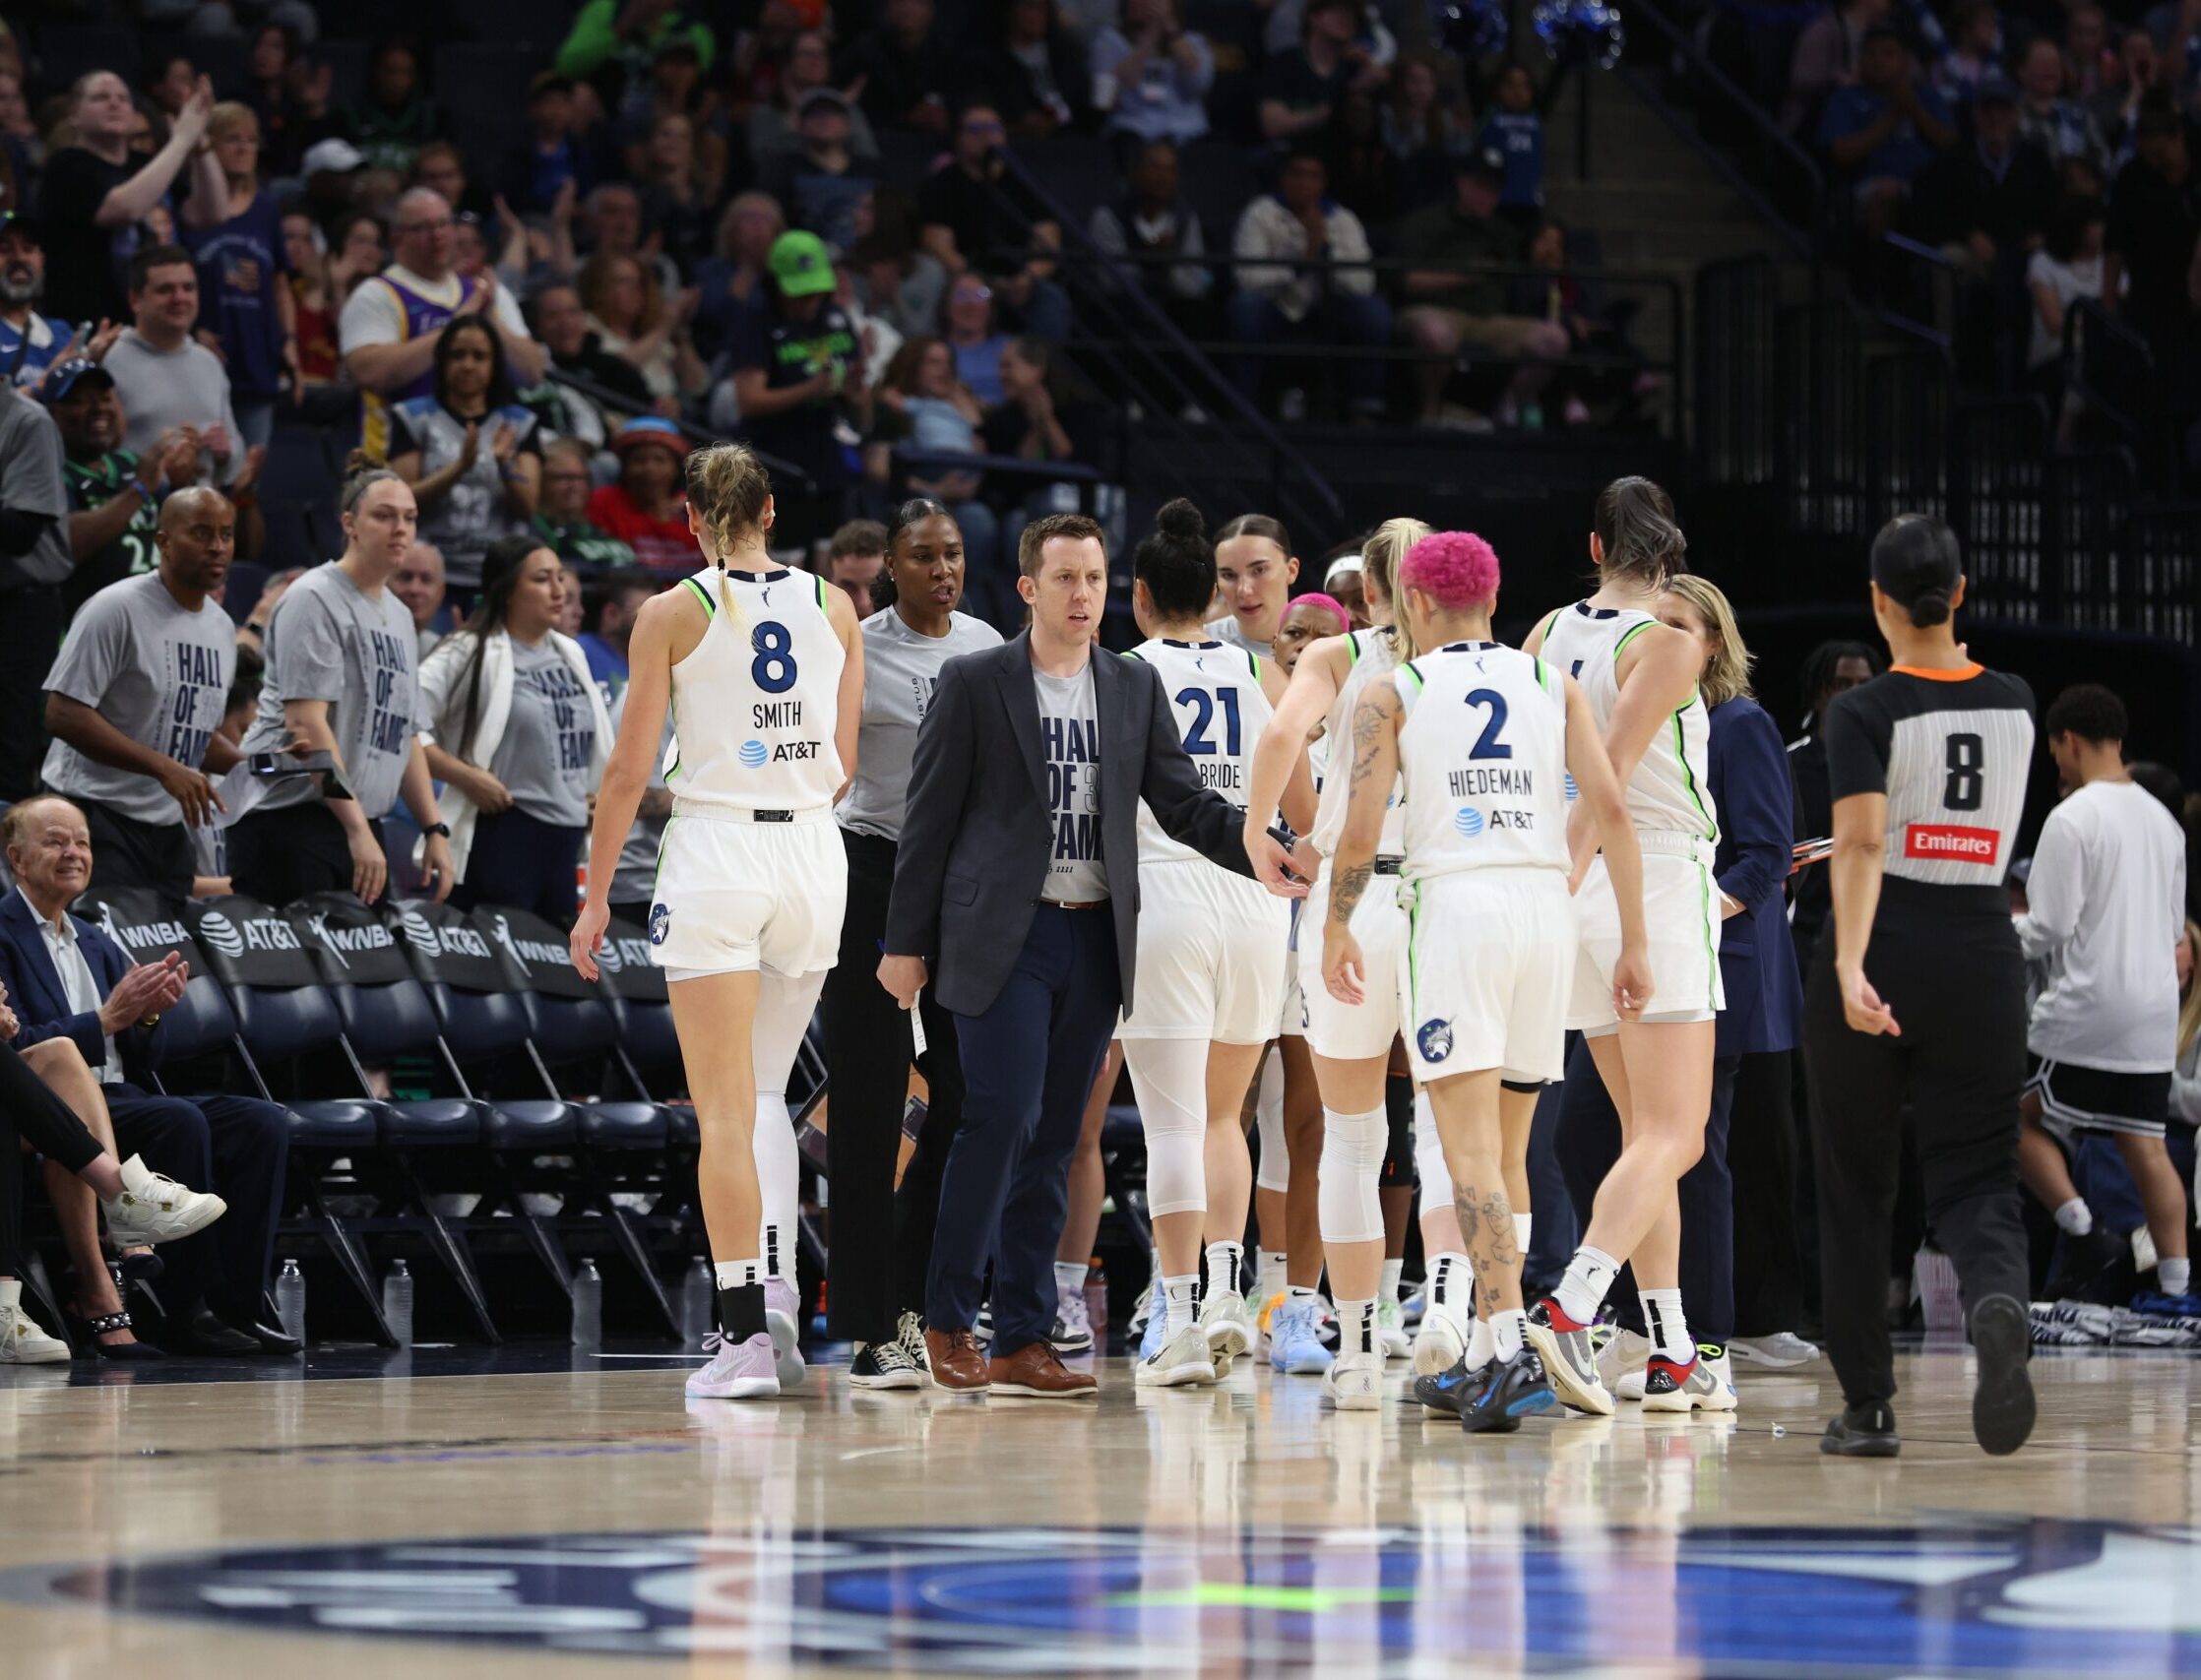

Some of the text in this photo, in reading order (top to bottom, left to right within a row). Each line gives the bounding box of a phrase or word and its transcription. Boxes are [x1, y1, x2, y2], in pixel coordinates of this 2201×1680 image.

[177, 643, 222, 688] HALL
[370, 629, 409, 675] HALL
[751, 621, 797, 694] 8
[173, 684, 200, 725] OF
[376, 668, 395, 709] OF
[753, 701, 801, 728] SMITH
[1174, 687, 1241, 756] 21
[1464, 688, 1513, 761] 2
[169, 725, 214, 766] FAM
[559, 731, 596, 770] FAM
[773, 741, 821, 762] AT&T
[1040, 716, 1100, 763] HAL
[1084, 765, 1100, 813] 3
[1200, 764, 1241, 788] BRIDE
[1448, 769, 1533, 797] HIEDEMAN
[1943, 733, 1984, 812] 8
[1052, 813, 1104, 860] AM
[1489, 810, 1534, 830] AT&T
[1914, 832, 1992, 855] Emirates
[120, 920, 192, 949] WNBA
[243, 918, 301, 951] AT&T
[438, 927, 491, 959] AT&T
[514, 940, 572, 965] WNB
[622, 938, 662, 968] AT
